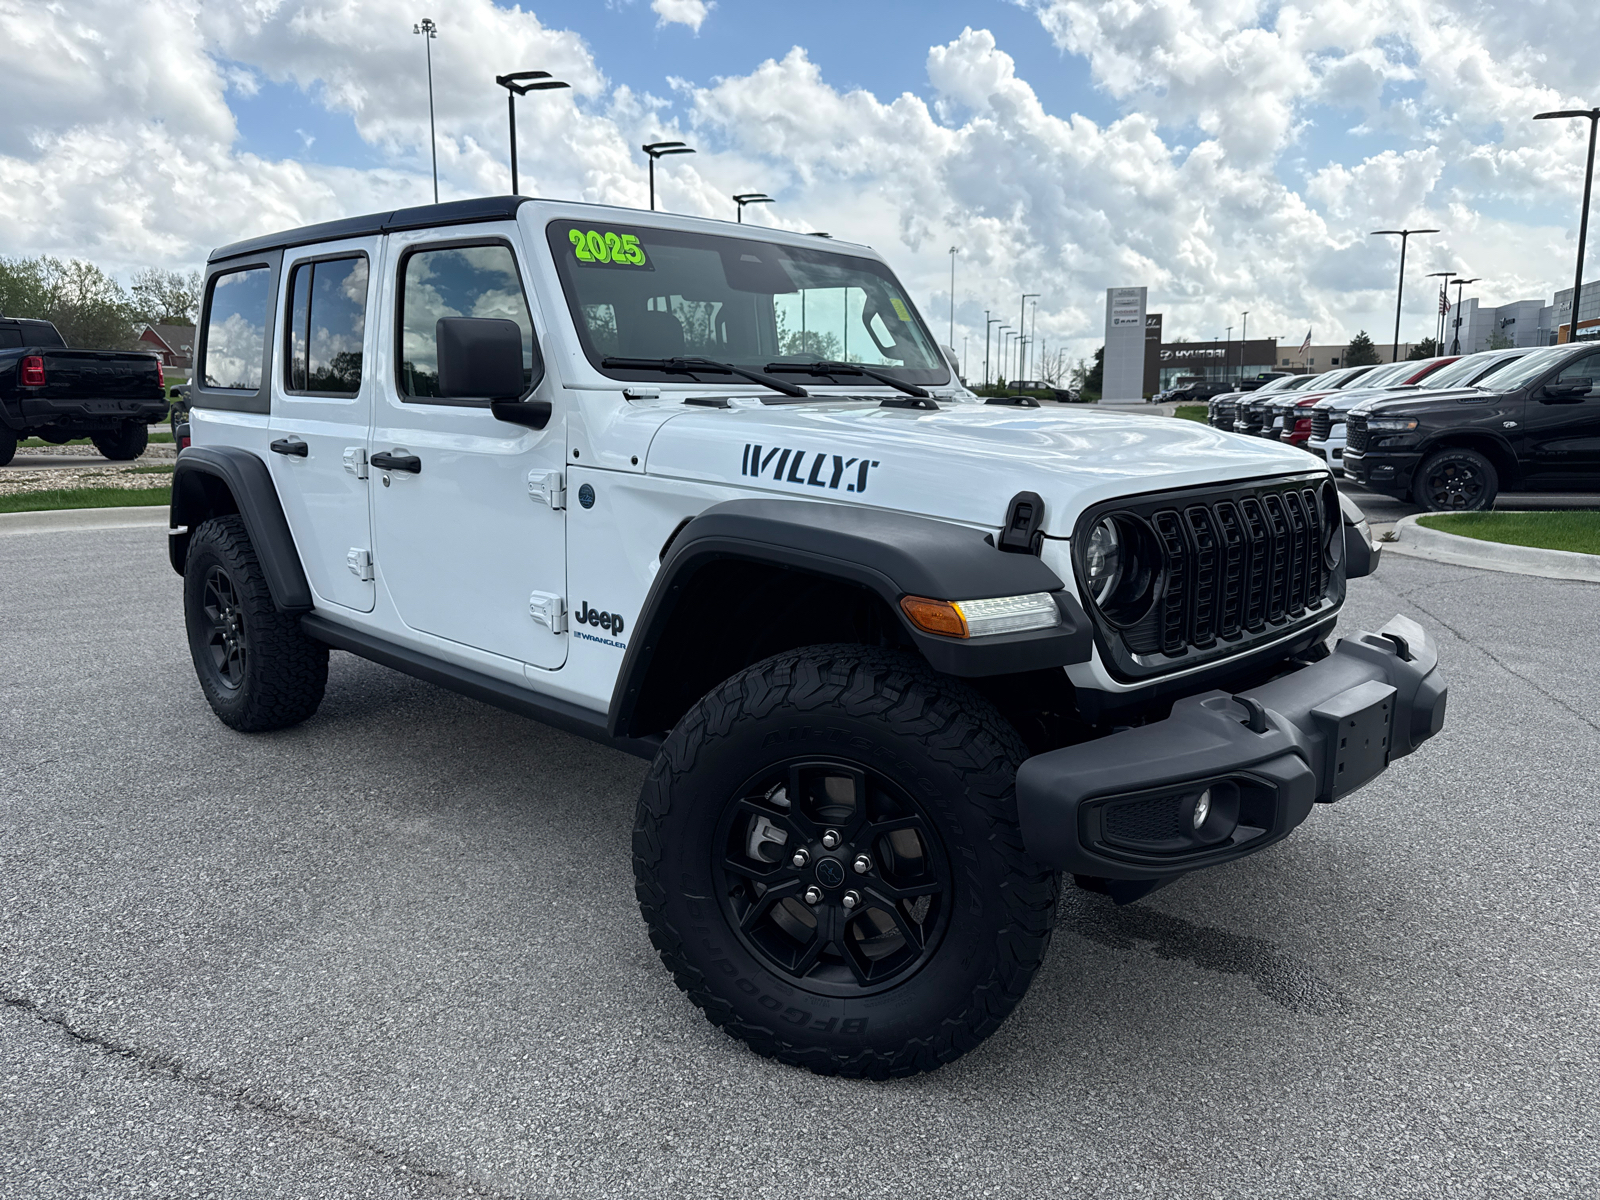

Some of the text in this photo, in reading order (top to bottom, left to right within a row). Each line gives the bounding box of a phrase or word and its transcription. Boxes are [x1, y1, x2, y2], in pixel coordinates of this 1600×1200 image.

[569, 229, 646, 266] 2025
[1175, 349, 1226, 359] HYUNDAI
[742, 443, 880, 493] WILLYS
[575, 600, 624, 636] Jeep
[581, 632, 626, 650] WRANGLER
[679, 871, 869, 1036] BFGoodrich
